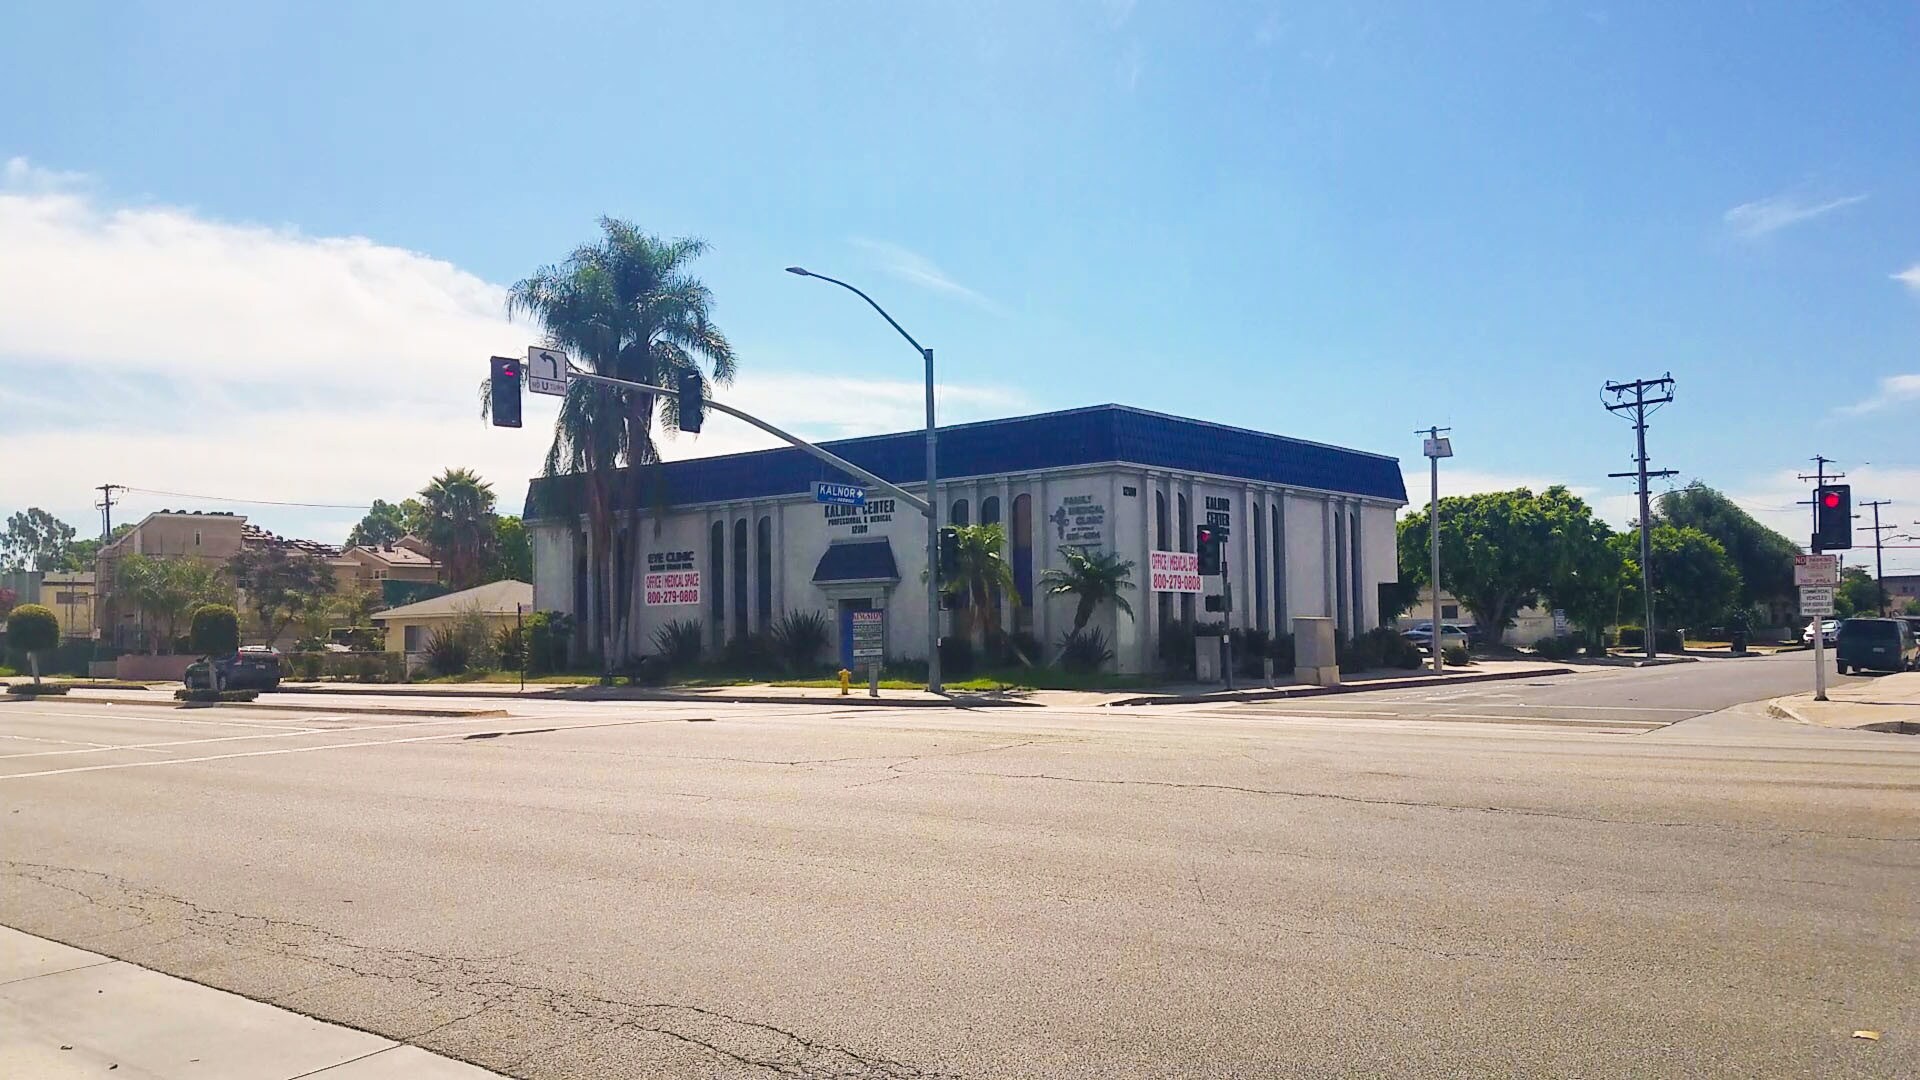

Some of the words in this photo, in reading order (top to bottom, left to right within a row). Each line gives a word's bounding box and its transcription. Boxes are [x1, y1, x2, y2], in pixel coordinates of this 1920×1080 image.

[541, 381, 549, 391] U
[819, 485, 855, 498] KALNOR
[862, 499, 895, 515] CENTER
[665, 551, 695, 562] CLINIC
[1795, 556, 1806, 565] NO
[1153, 573, 1201, 590] 800-279-0808
[647, 589, 698, 604] 800-279-0808
